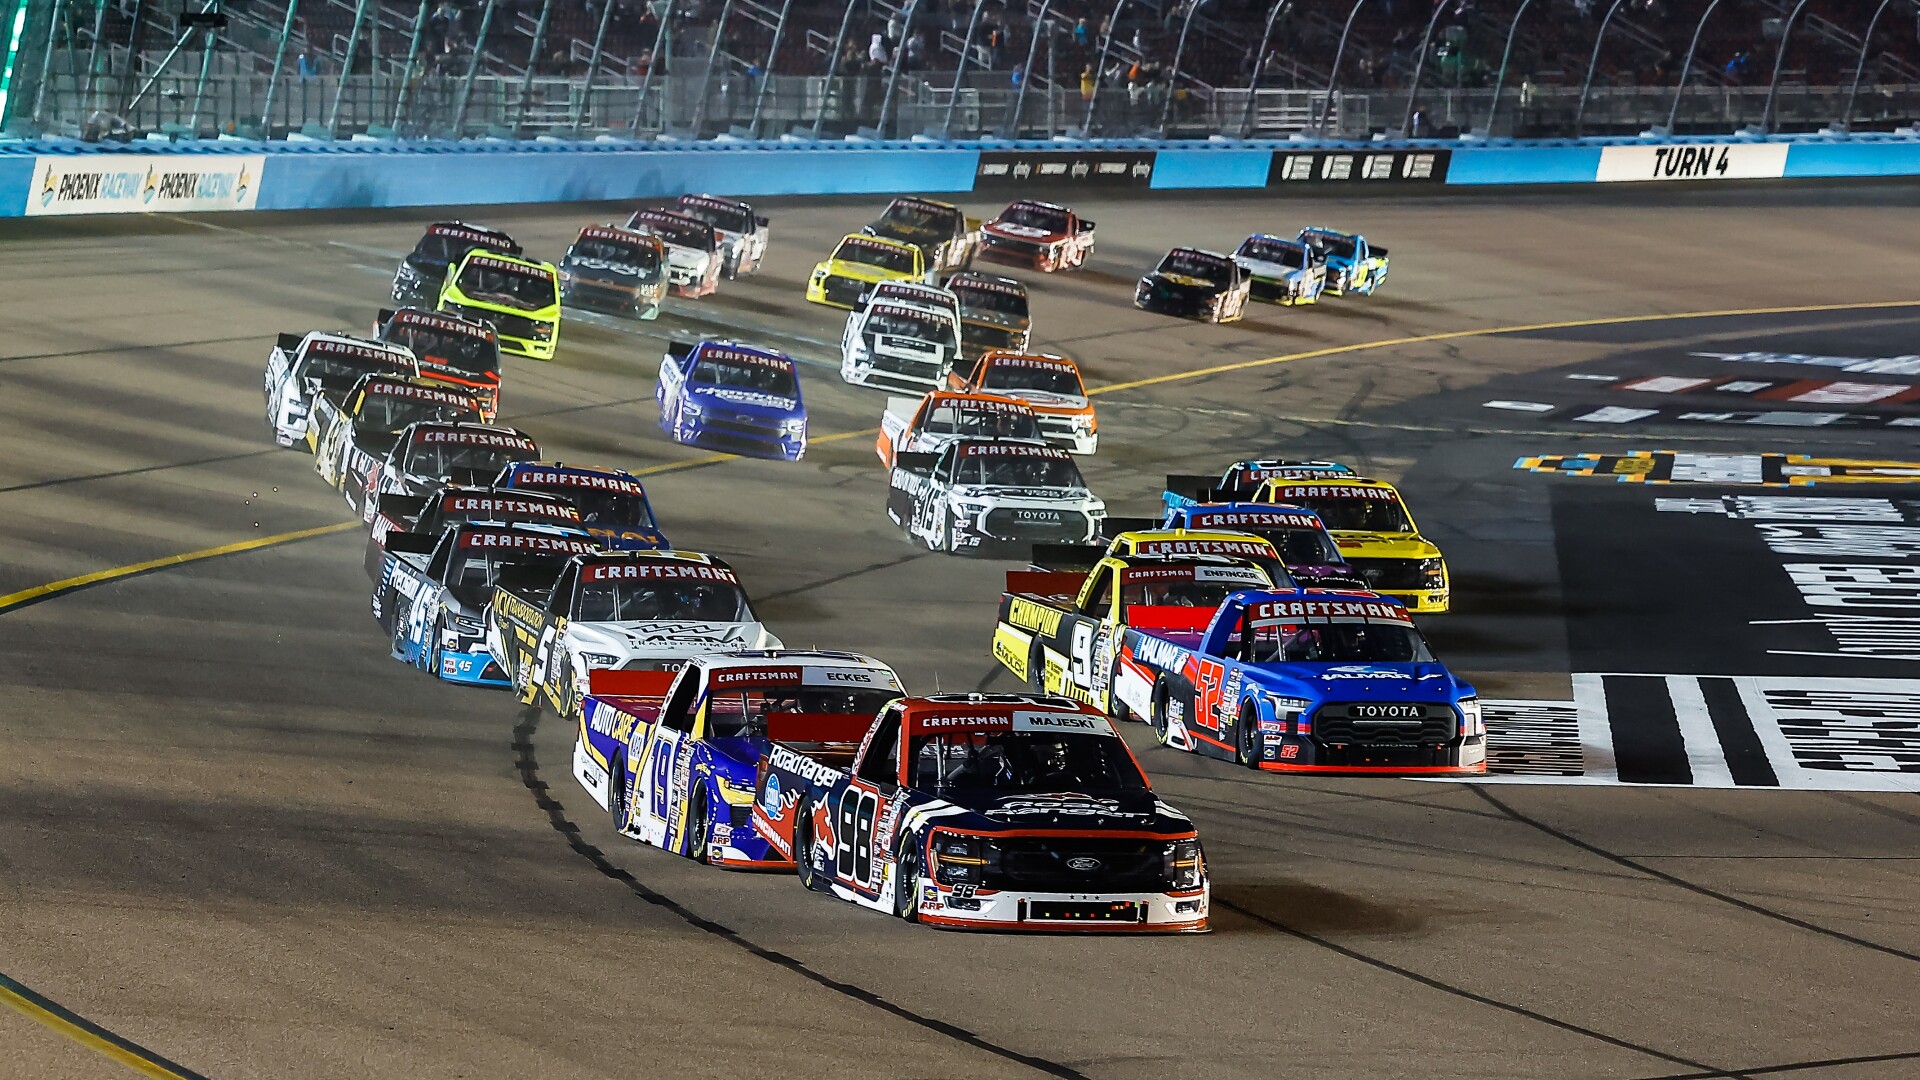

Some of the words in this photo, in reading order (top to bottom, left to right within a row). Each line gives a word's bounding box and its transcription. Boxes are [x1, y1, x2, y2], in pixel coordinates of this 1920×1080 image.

[1653, 147, 1714, 177] TURN
[1715, 146, 1730, 176] 4
[58, 173, 102, 201] PHOENIX
[101, 173, 143, 200] RACEWAY
[158, 173, 199, 200] PHOENIX
[197, 172, 236, 199] RACEWAY
[435, 227, 506, 248] CRAFTSMAN
[587, 229, 653, 248] CRAFTSMAN
[473, 257, 547, 278] CRAFTSMAN
[403, 314, 487, 338] CRAFTSMAN
[316, 341, 409, 365] CRAFTSMAN
[707, 350, 788, 371] CRAFTSMAN
[995, 358, 1068, 374] CRAFTSMAN
[373, 383, 468, 407] CRAFTSMAN
[941, 398, 1028, 415] CRAFTSMAN
[424, 432, 527, 450] CRAFTSMAN
[968, 446, 1064, 459] CRAFTSMAN
[522, 472, 631, 492] CRAFTSMAN
[1284, 488, 1390, 500] CRAFTSMAN
[455, 499, 570, 519] CRAFTSMAN
[1017, 510, 1060, 520] TOYOTA
[1202, 514, 1313, 527] CRAFTSMAN
[471, 533, 597, 554] CRAFTSMAN
[968, 537, 982, 547] 15
[1149, 541, 1268, 556] CRAFTSMAN
[594, 565, 725, 581] CRAFTSMAN
[1129, 570, 1193, 579] CRAFTSMAN
[1203, 569, 1257, 579] ENFINGER
[1010, 599, 1062, 637] CHAMPION
[1259, 602, 1397, 619] CRAFTSMAN
[629, 640, 748, 649] TRANSFORMERS
[1138, 634, 1178, 672] HALMAR
[533, 624, 557, 687] 5
[1001, 650, 1026, 677] MULCH
[1070, 620, 1094, 690] 9
[458, 660, 473, 672] 45
[717, 672, 799, 682] CRAFTSMAN
[826, 672, 872, 683] ECKES
[1194, 657, 1226, 732] 52
[1356, 706, 1419, 717] TOYOTA
[590, 701, 617, 737] AUTO
[611, 710, 638, 746] CARE
[923, 716, 1009, 727] CRAFTSMAN
[1029, 716, 1096, 729] MAJESKI
[629, 733, 645, 760] NAPA
[1280, 744, 1299, 759] 52
[769, 744, 804, 778] Road
[797, 753, 842, 788] Ranger
[650, 735, 674, 825] 19
[752, 812, 792, 857] CINCINNATI
[837, 784, 878, 889] 98
[1072, 858, 1095, 870] Ford
[952, 883, 979, 898] 98
[920, 902, 945, 911] ARP
